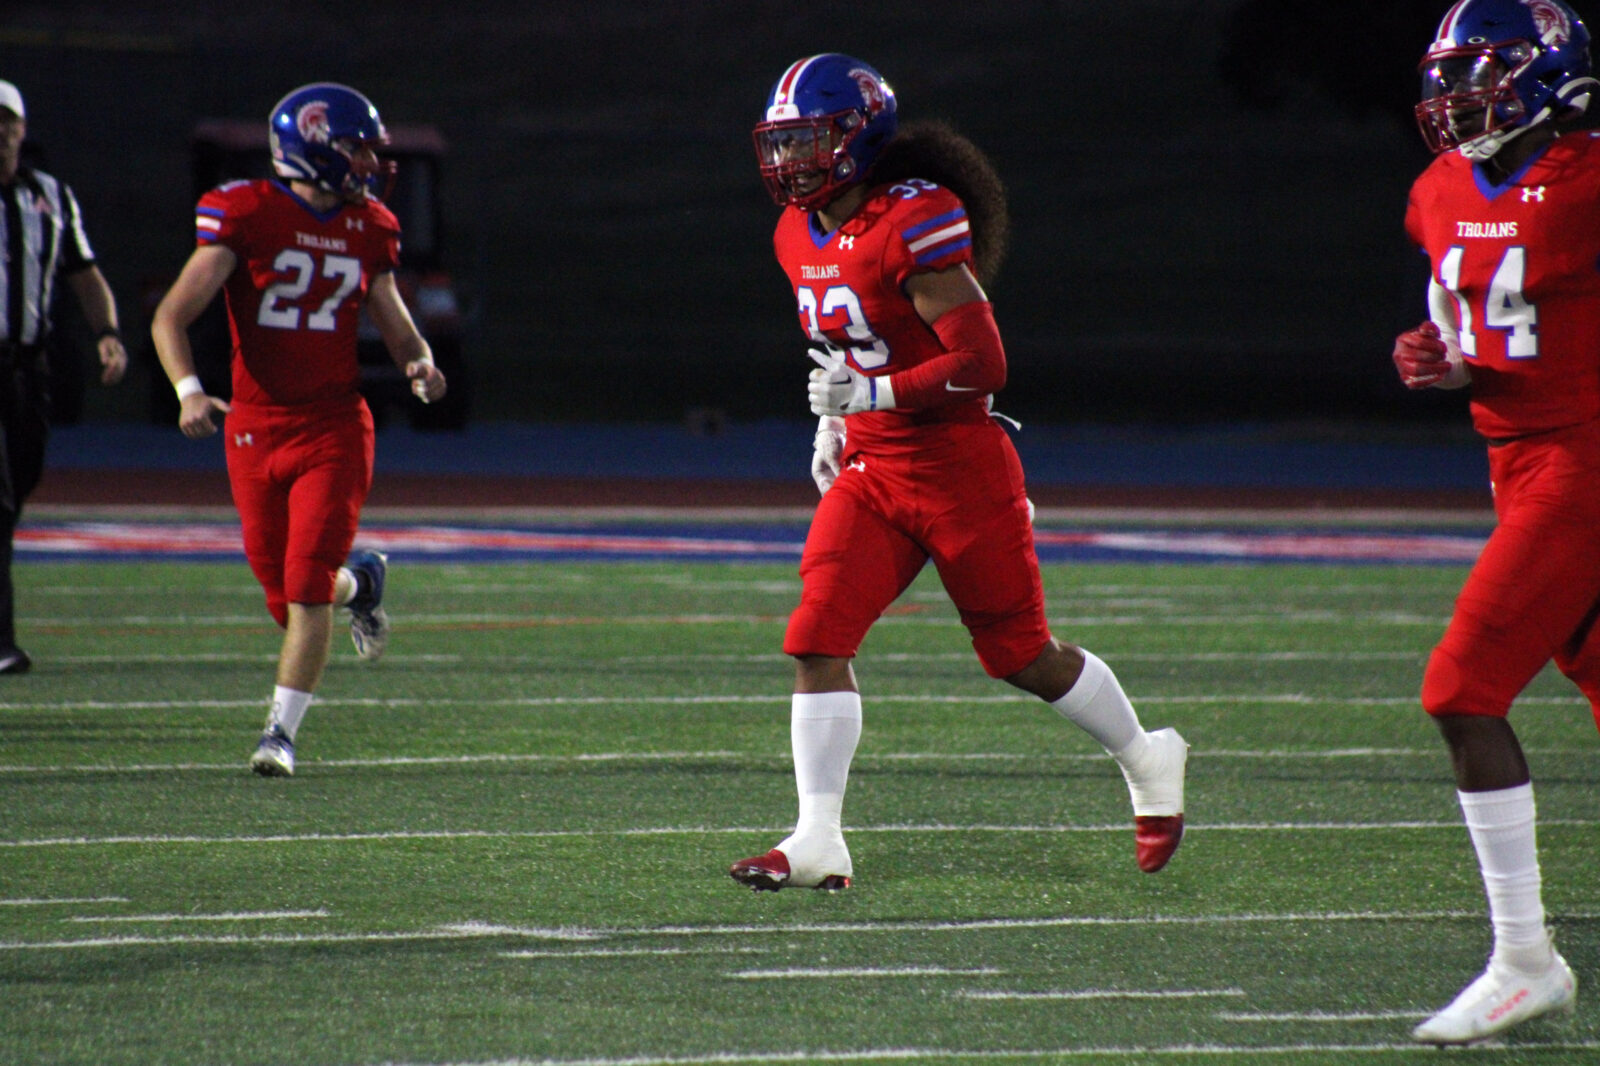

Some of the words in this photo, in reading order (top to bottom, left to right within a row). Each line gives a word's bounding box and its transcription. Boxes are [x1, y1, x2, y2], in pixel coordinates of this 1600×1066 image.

[1457, 222, 1518, 237] TROJANS
[296, 232, 346, 251] TROJANS
[801, 265, 840, 279] TROJANS
[257, 249, 361, 331] 27
[1440, 245, 1538, 358] 14
